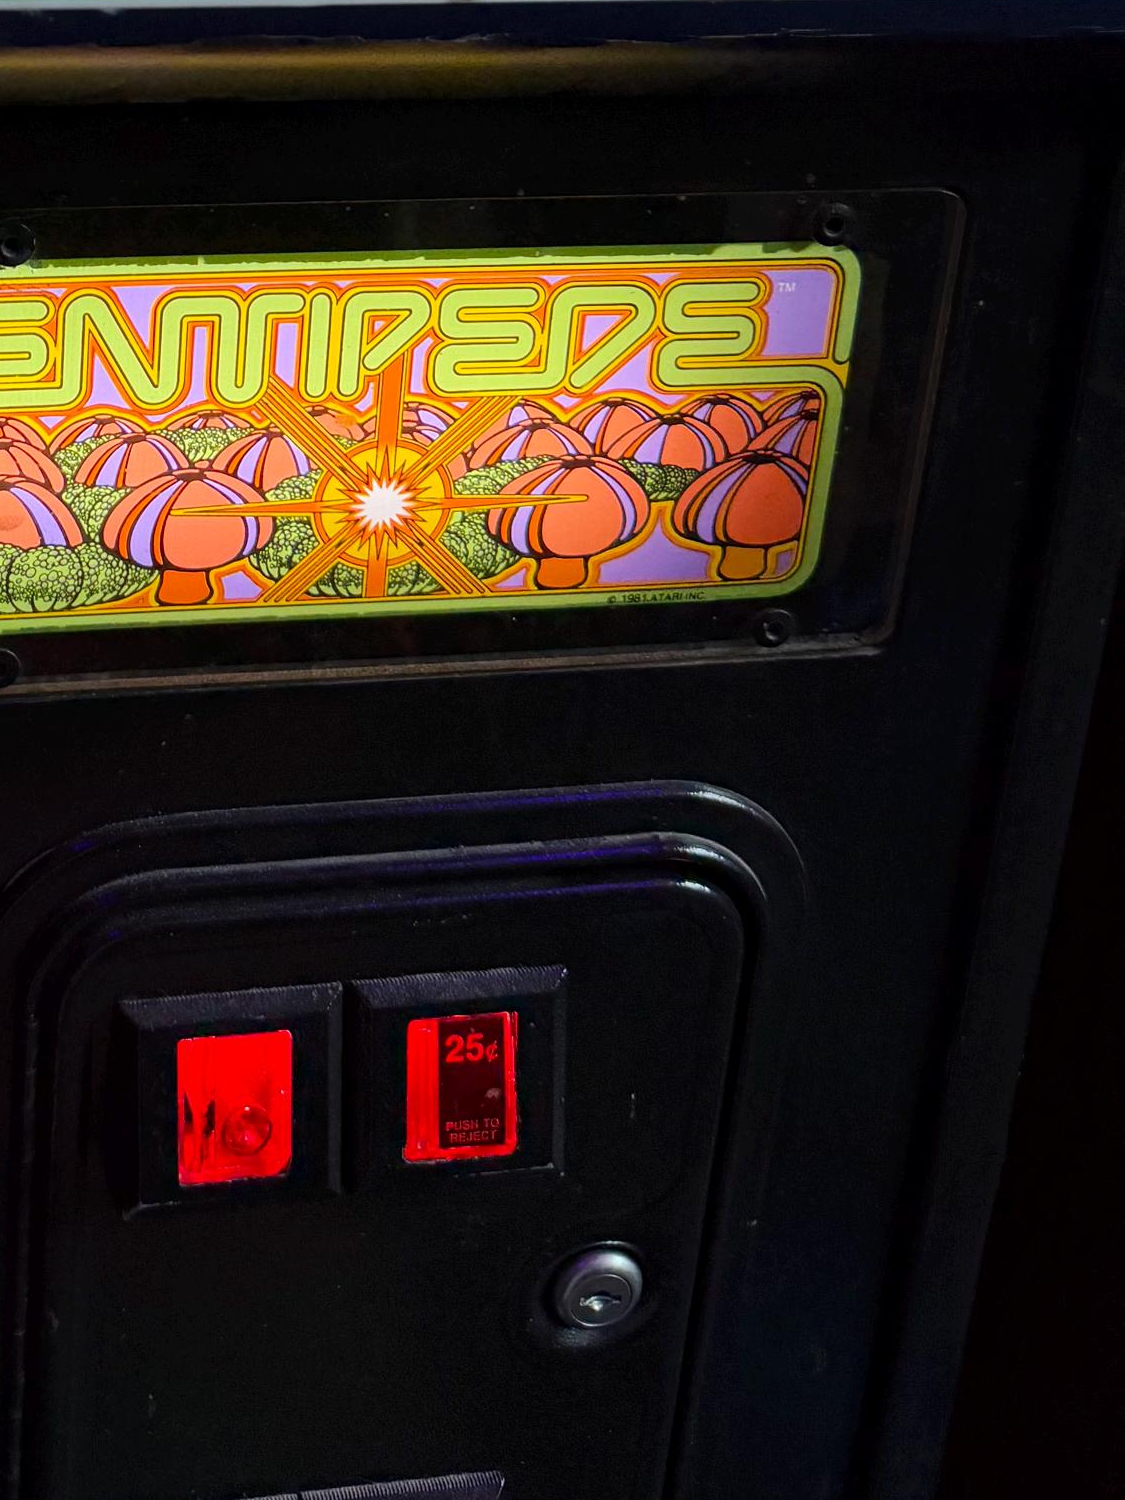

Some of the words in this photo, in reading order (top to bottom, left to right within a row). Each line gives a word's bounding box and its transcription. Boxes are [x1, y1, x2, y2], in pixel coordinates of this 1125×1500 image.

[444, 1032, 499, 1064] 25¢
[445, 1119, 480, 1132] PUSH
[484, 1117, 500, 1129] TO
[449, 1129, 498, 1143] REJECT
